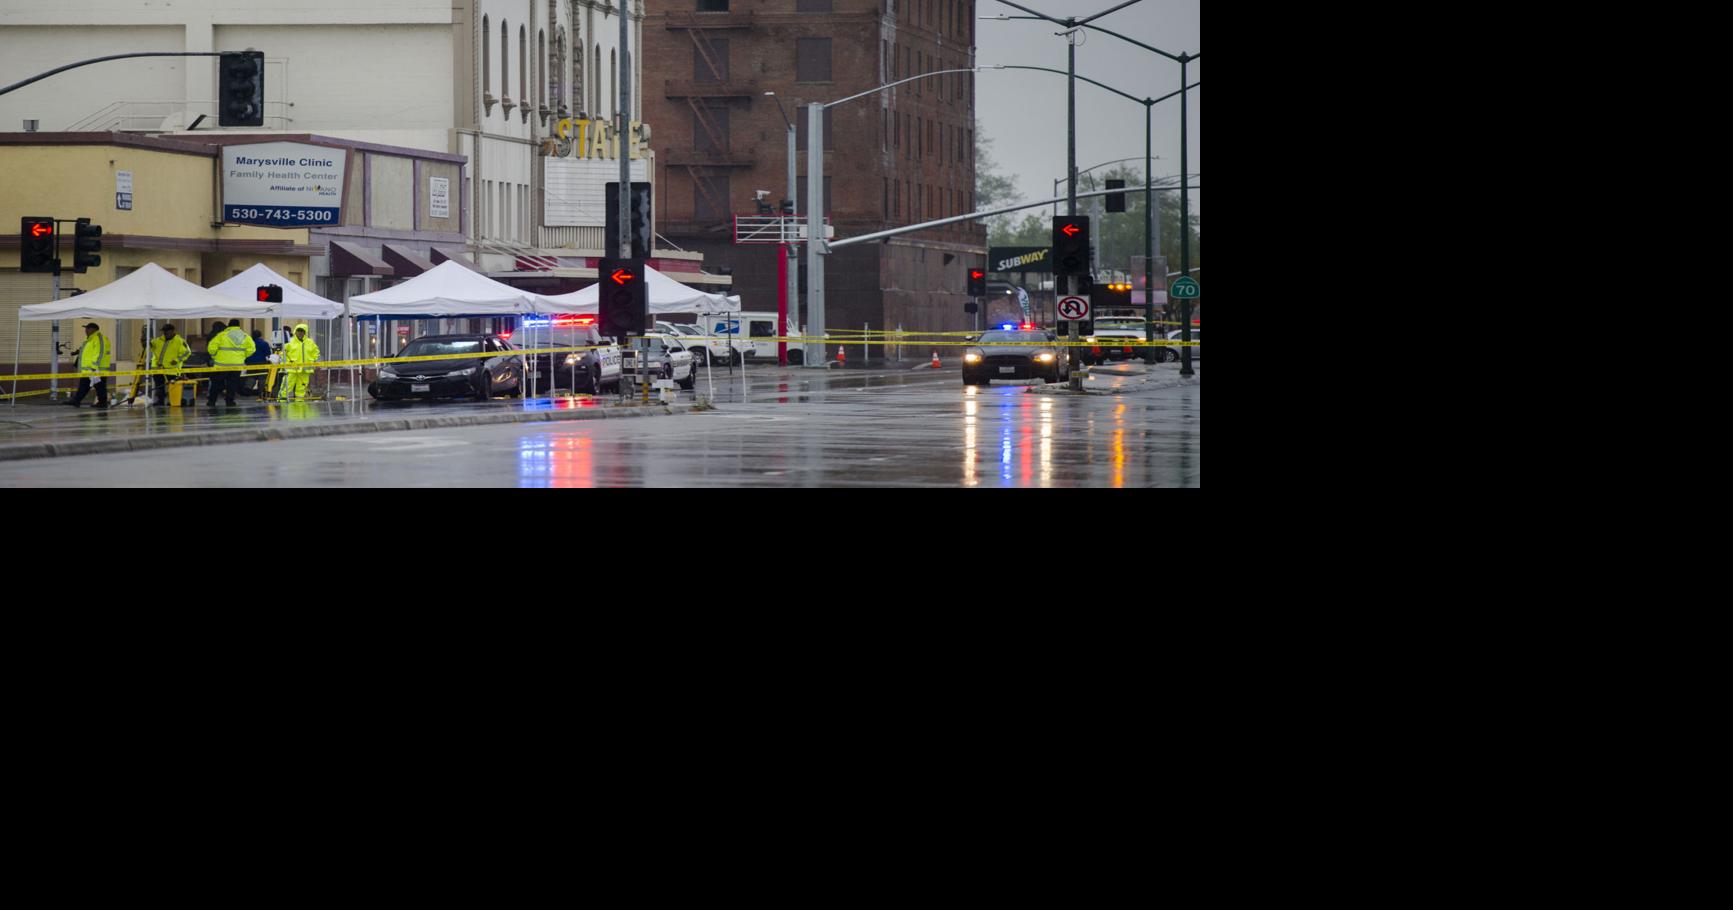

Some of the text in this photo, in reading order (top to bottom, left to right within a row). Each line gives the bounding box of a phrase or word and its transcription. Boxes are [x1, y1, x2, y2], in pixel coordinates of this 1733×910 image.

[236, 157, 333, 167] Marysville Clinic
[230, 170, 338, 180] Family Health Center
[232, 208, 332, 221] 530-743-5300
[997, 249, 1049, 271] SUBWAY
[1176, 285, 1195, 295] 70
